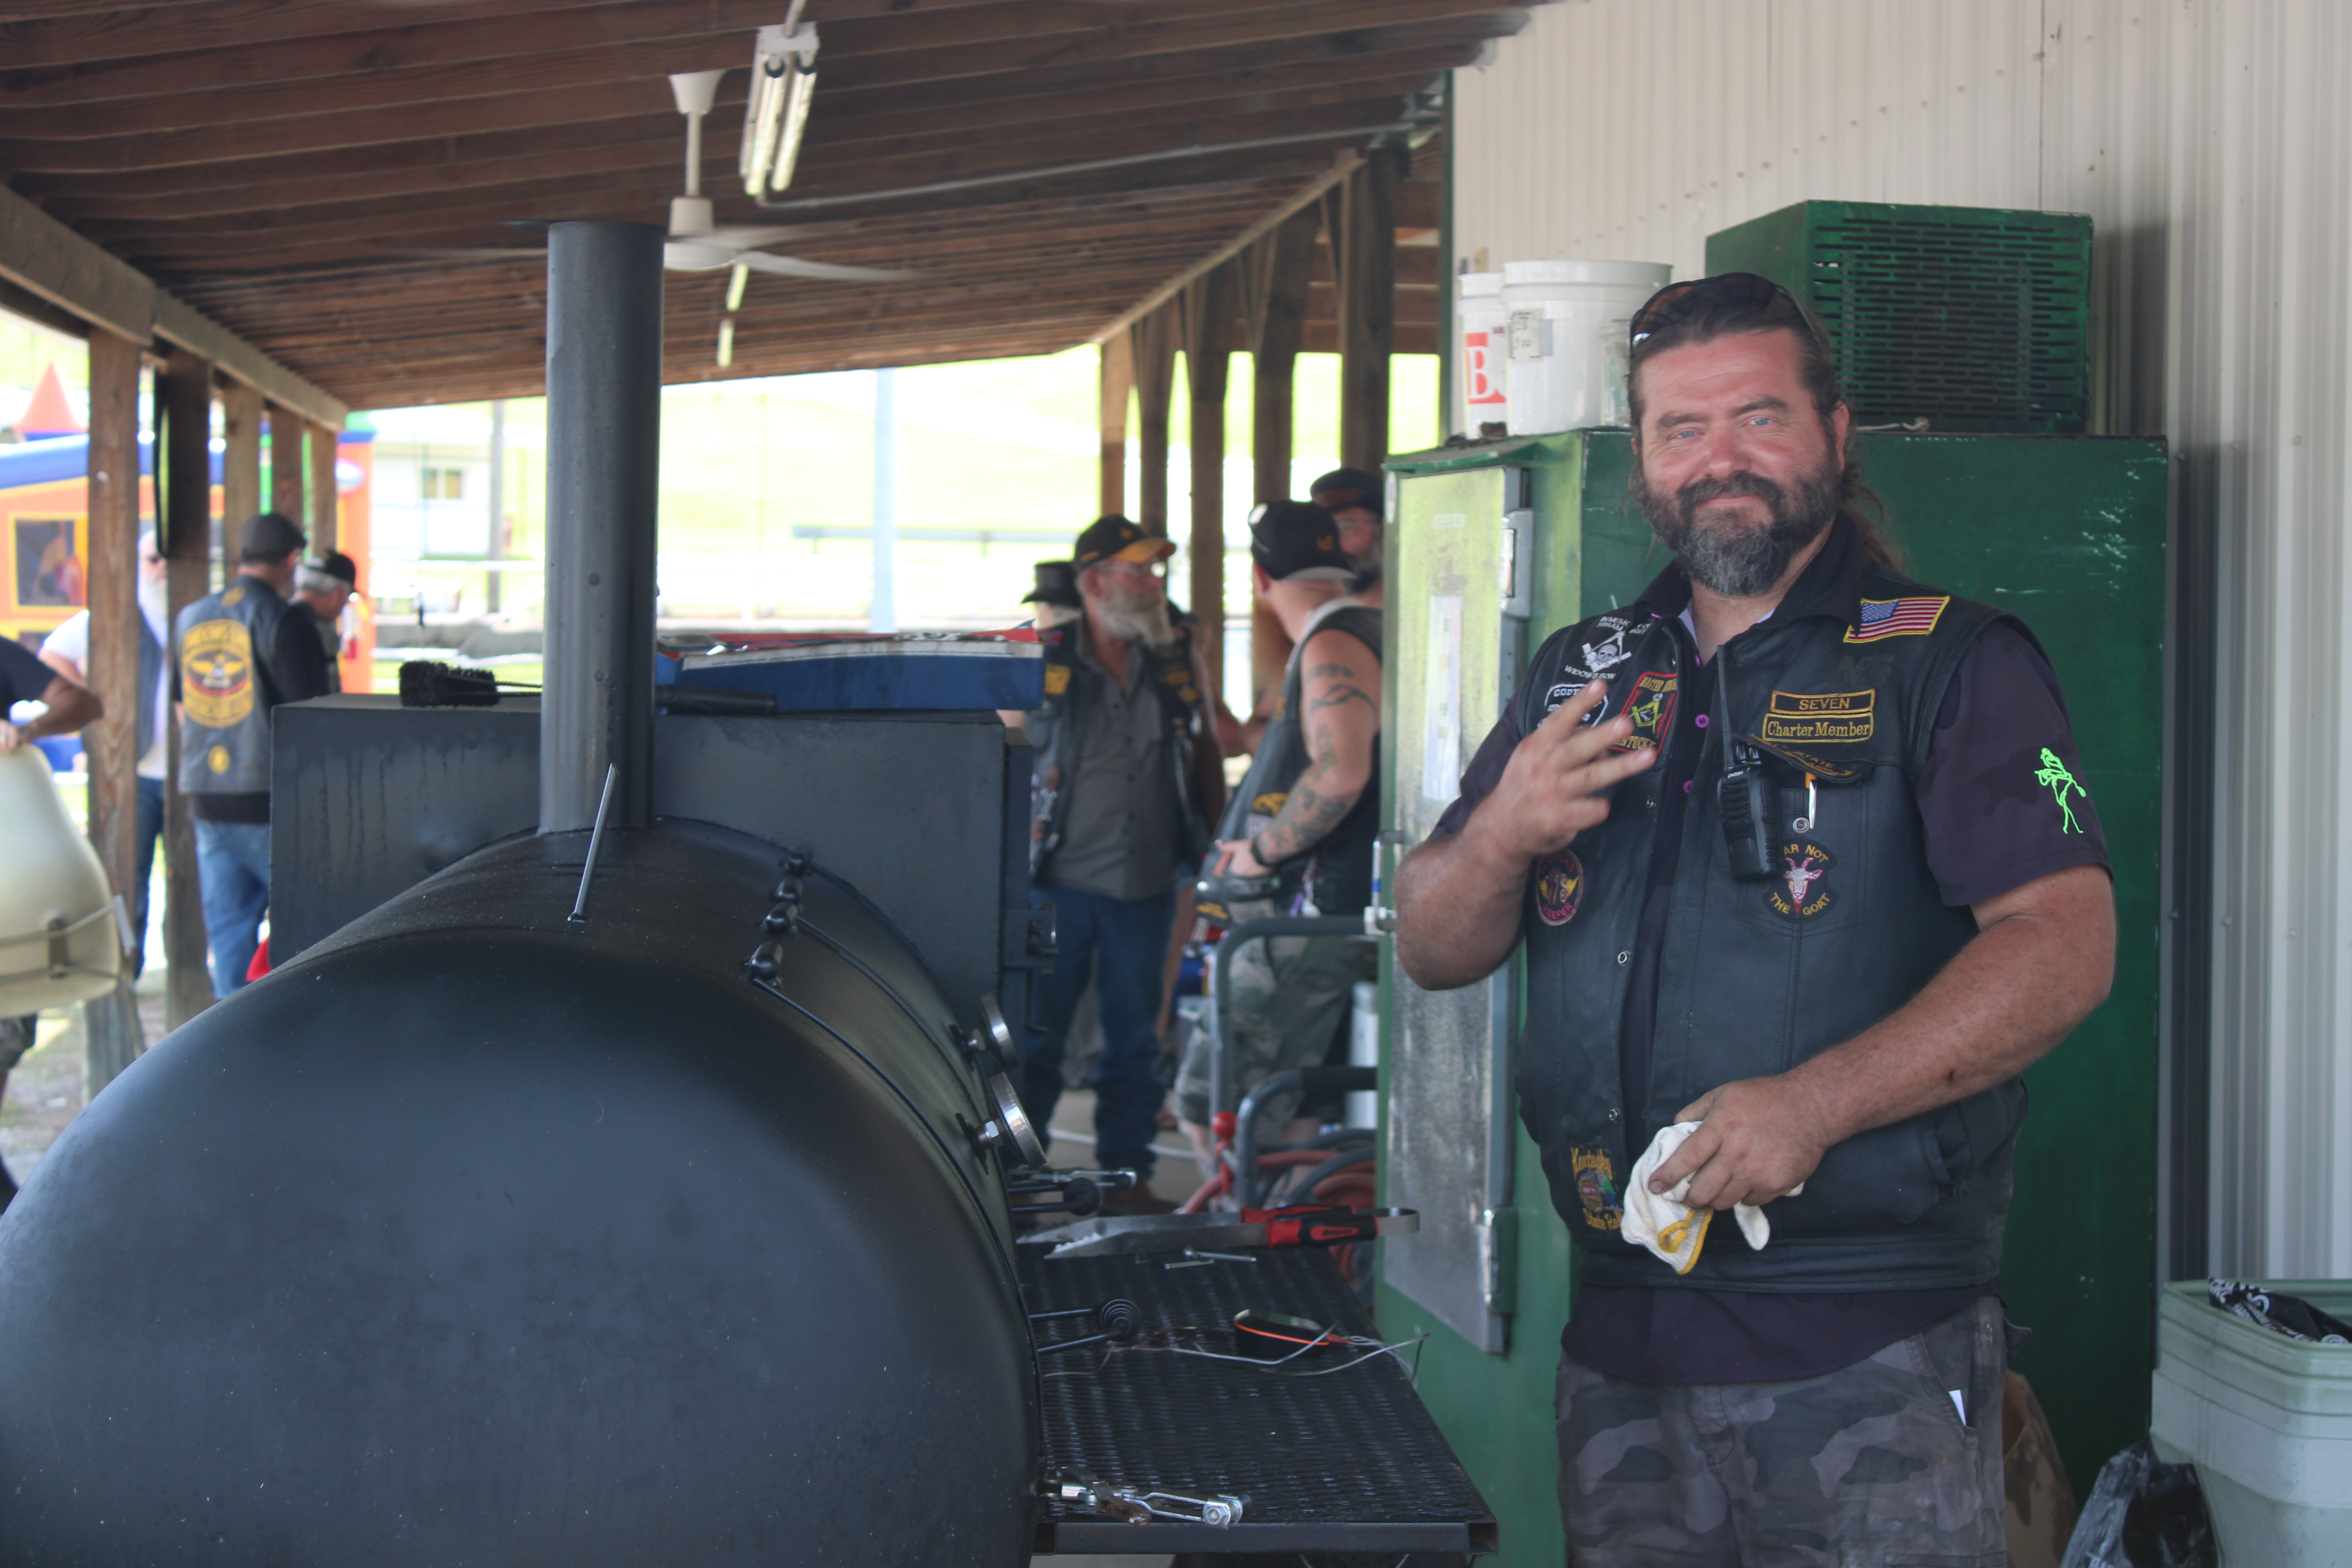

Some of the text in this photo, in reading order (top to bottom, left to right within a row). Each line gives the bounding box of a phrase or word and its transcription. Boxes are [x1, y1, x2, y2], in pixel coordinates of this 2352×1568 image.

[1799, 697, 1850, 710] SEVEN
[1768, 720, 1870, 737] Charter Member
[1784, 844, 1829, 862] AR NOT
[1770, 892, 1830, 915] THE GOAT
